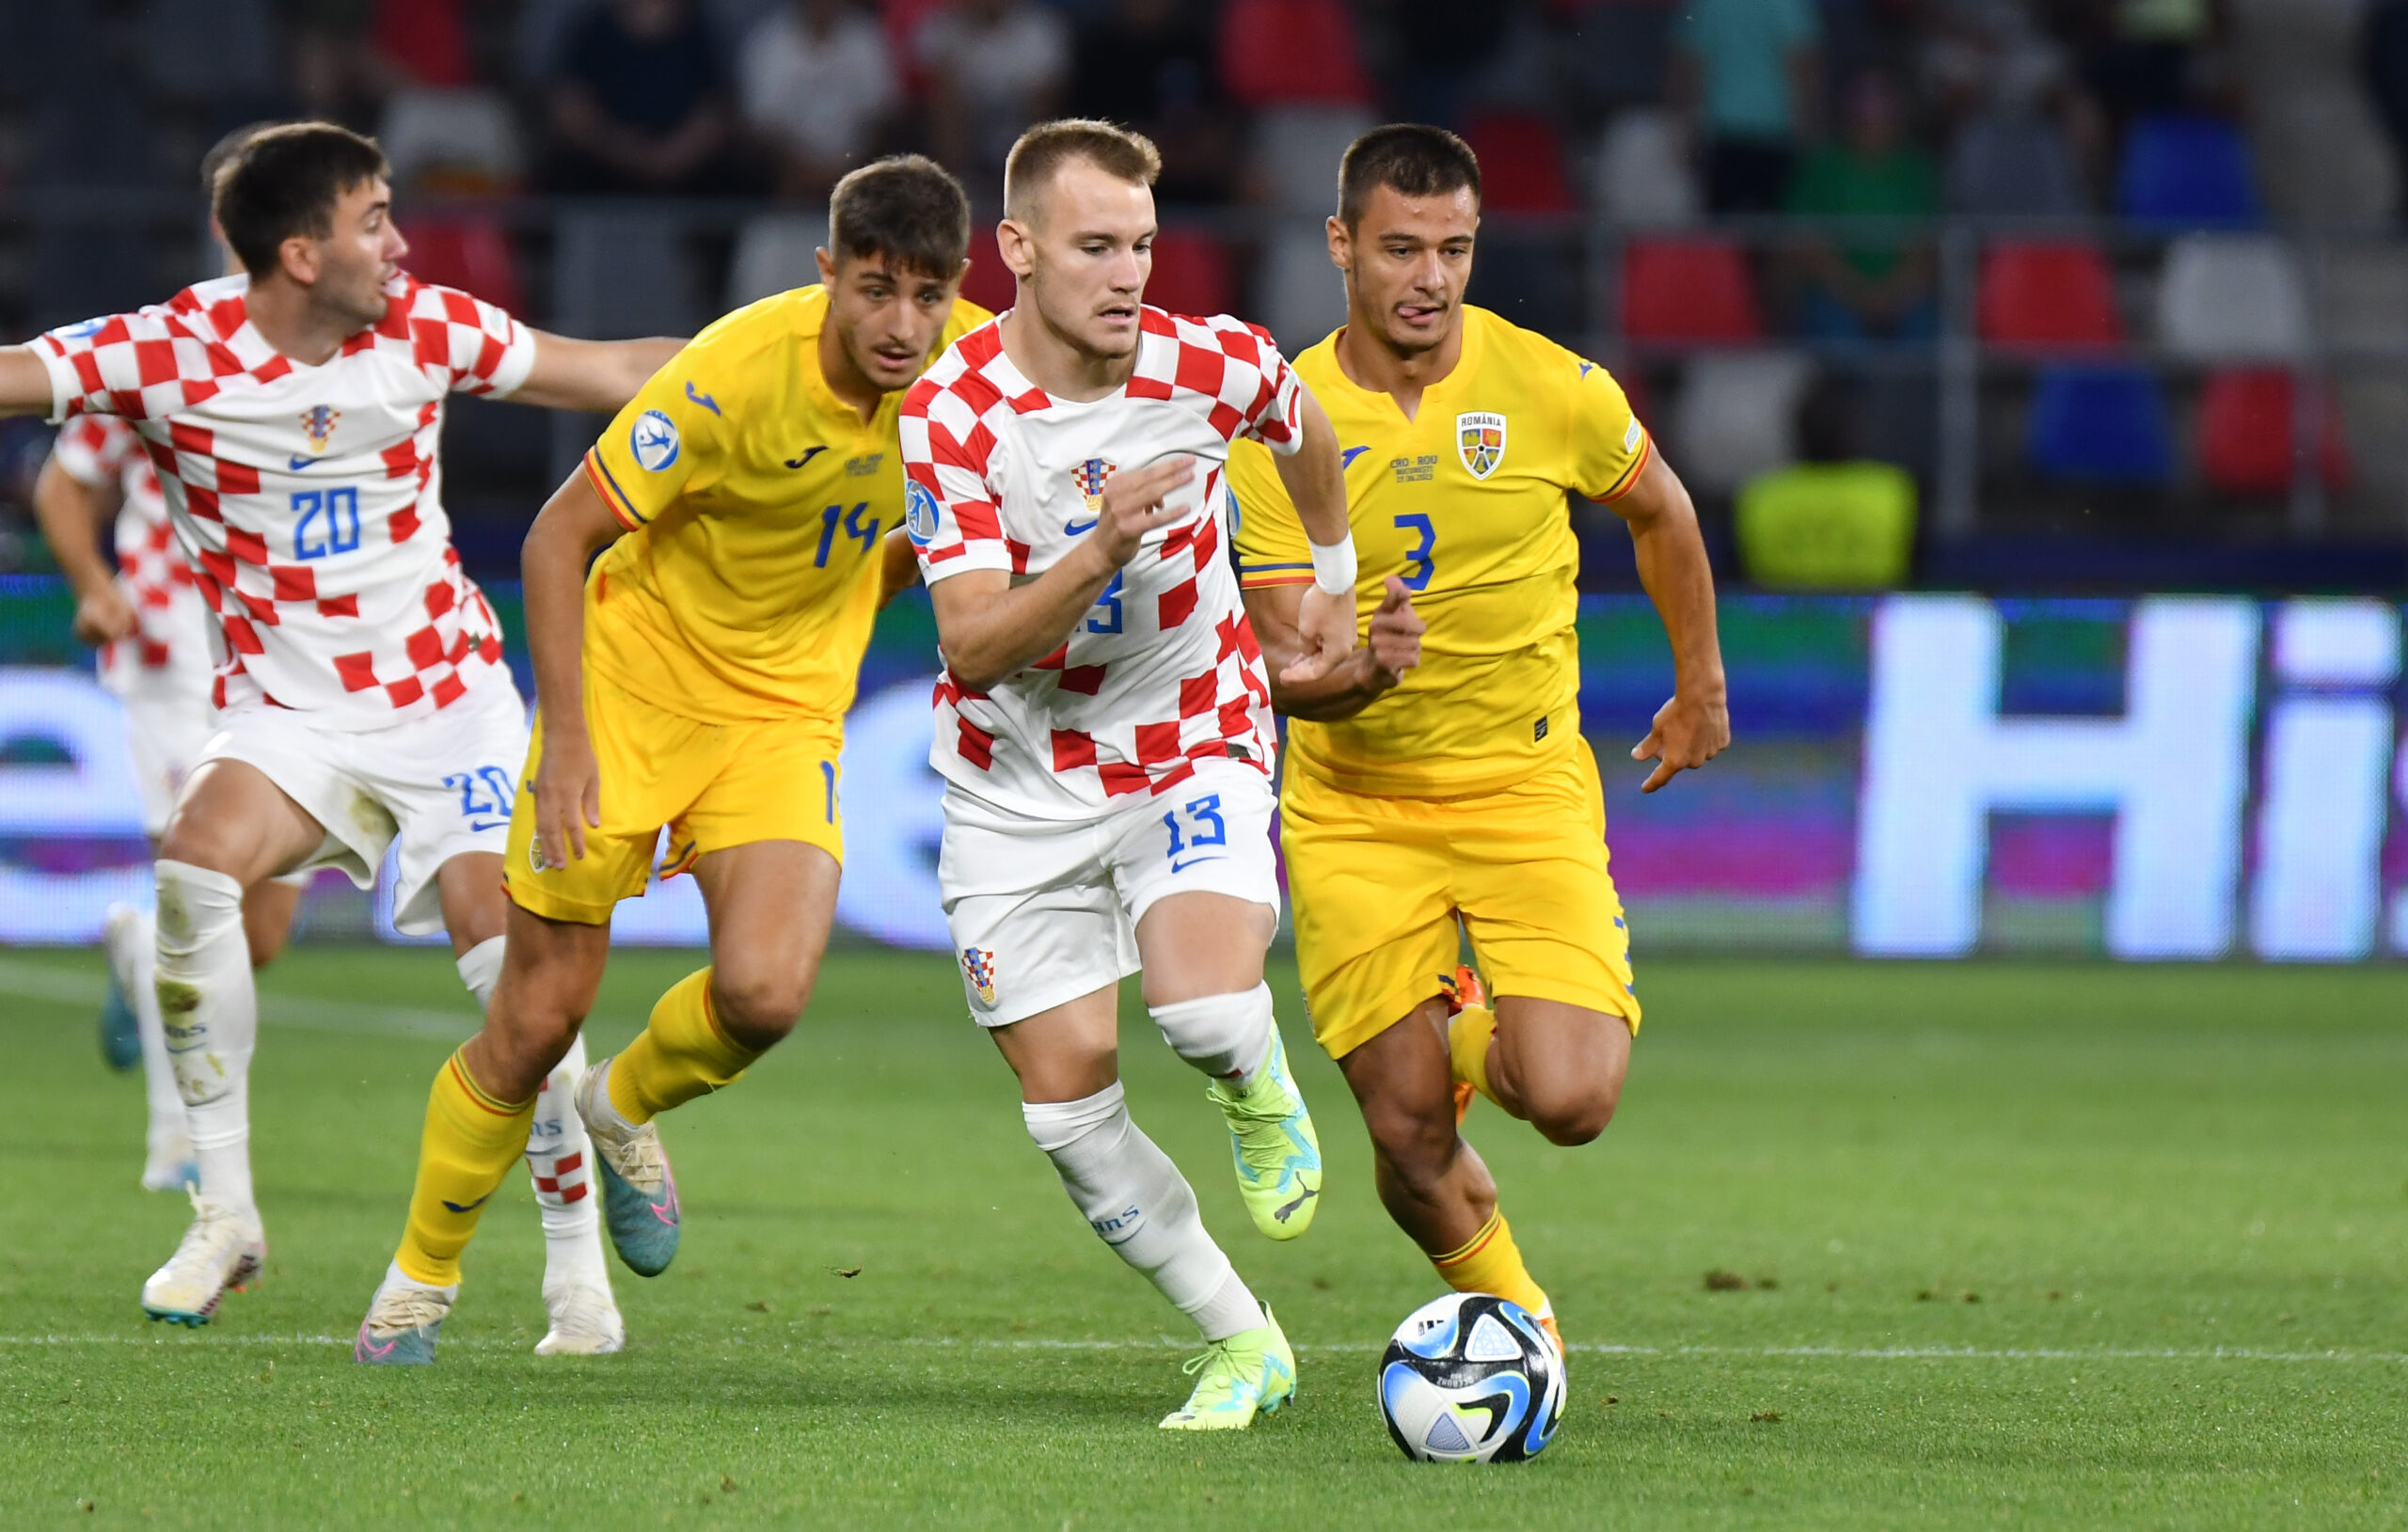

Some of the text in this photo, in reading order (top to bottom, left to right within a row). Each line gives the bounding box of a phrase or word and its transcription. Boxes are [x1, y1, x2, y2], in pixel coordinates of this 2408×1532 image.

[1390, 457, 1409, 468] CRO
[1418, 455, 1438, 466] ROU
[290, 485, 361, 561] 20
[813, 500, 880, 568] 14
[1394, 513, 1436, 592] 3
[1076, 565, 1123, 634] 3
[440, 765, 515, 817] 20
[1850, 591, 2408, 962] Hi
[1163, 793, 1227, 859] 13
